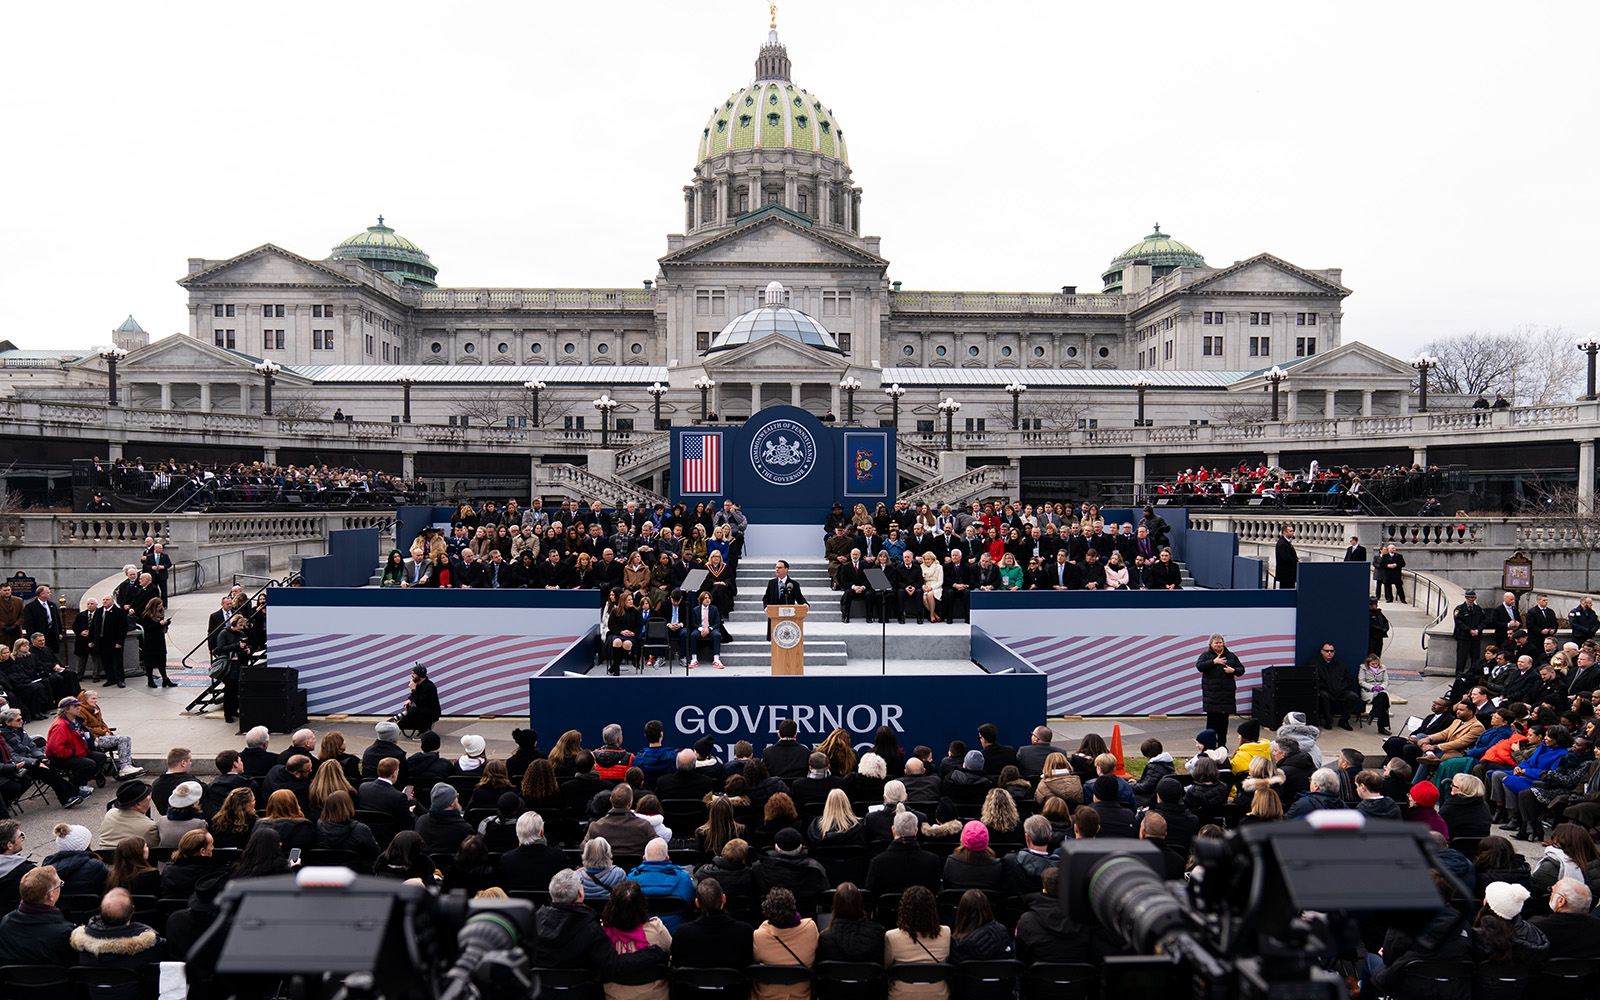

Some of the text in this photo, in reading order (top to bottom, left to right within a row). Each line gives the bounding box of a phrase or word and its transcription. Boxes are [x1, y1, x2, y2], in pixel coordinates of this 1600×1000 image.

[753, 423, 782, 464] COMMONWEALTH
[791, 424, 813, 463] PENNSYLVANIA
[761, 469, 805, 482] THE GOVERNOR
[674, 704, 905, 734] GOVERNOR
